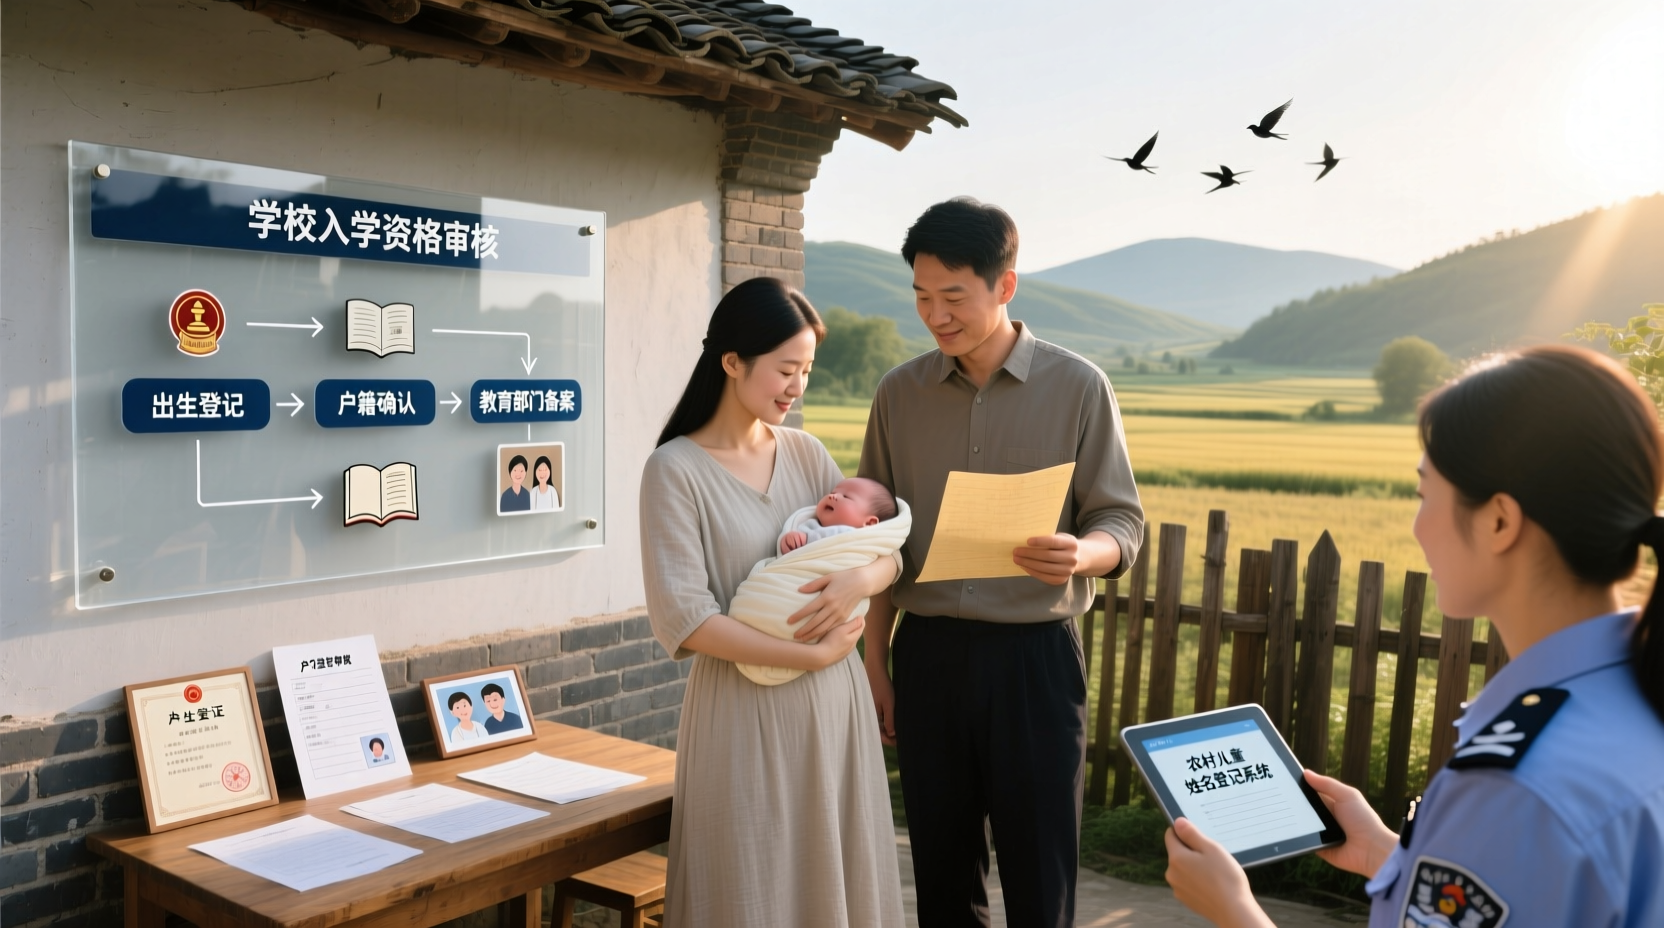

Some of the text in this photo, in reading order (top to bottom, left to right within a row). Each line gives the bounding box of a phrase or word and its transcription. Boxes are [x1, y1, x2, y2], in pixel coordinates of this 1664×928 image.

[248, 199, 499, 260] 学校入学资格审核
[152, 391, 244, 419] 出生登记
[338, 390, 416, 416] 户籍确认
[479, 389, 575, 414] 教育部门备案
[1186, 748, 1246, 772] 农村儿童
[1185, 763, 1273, 796] 姓名登记系统
